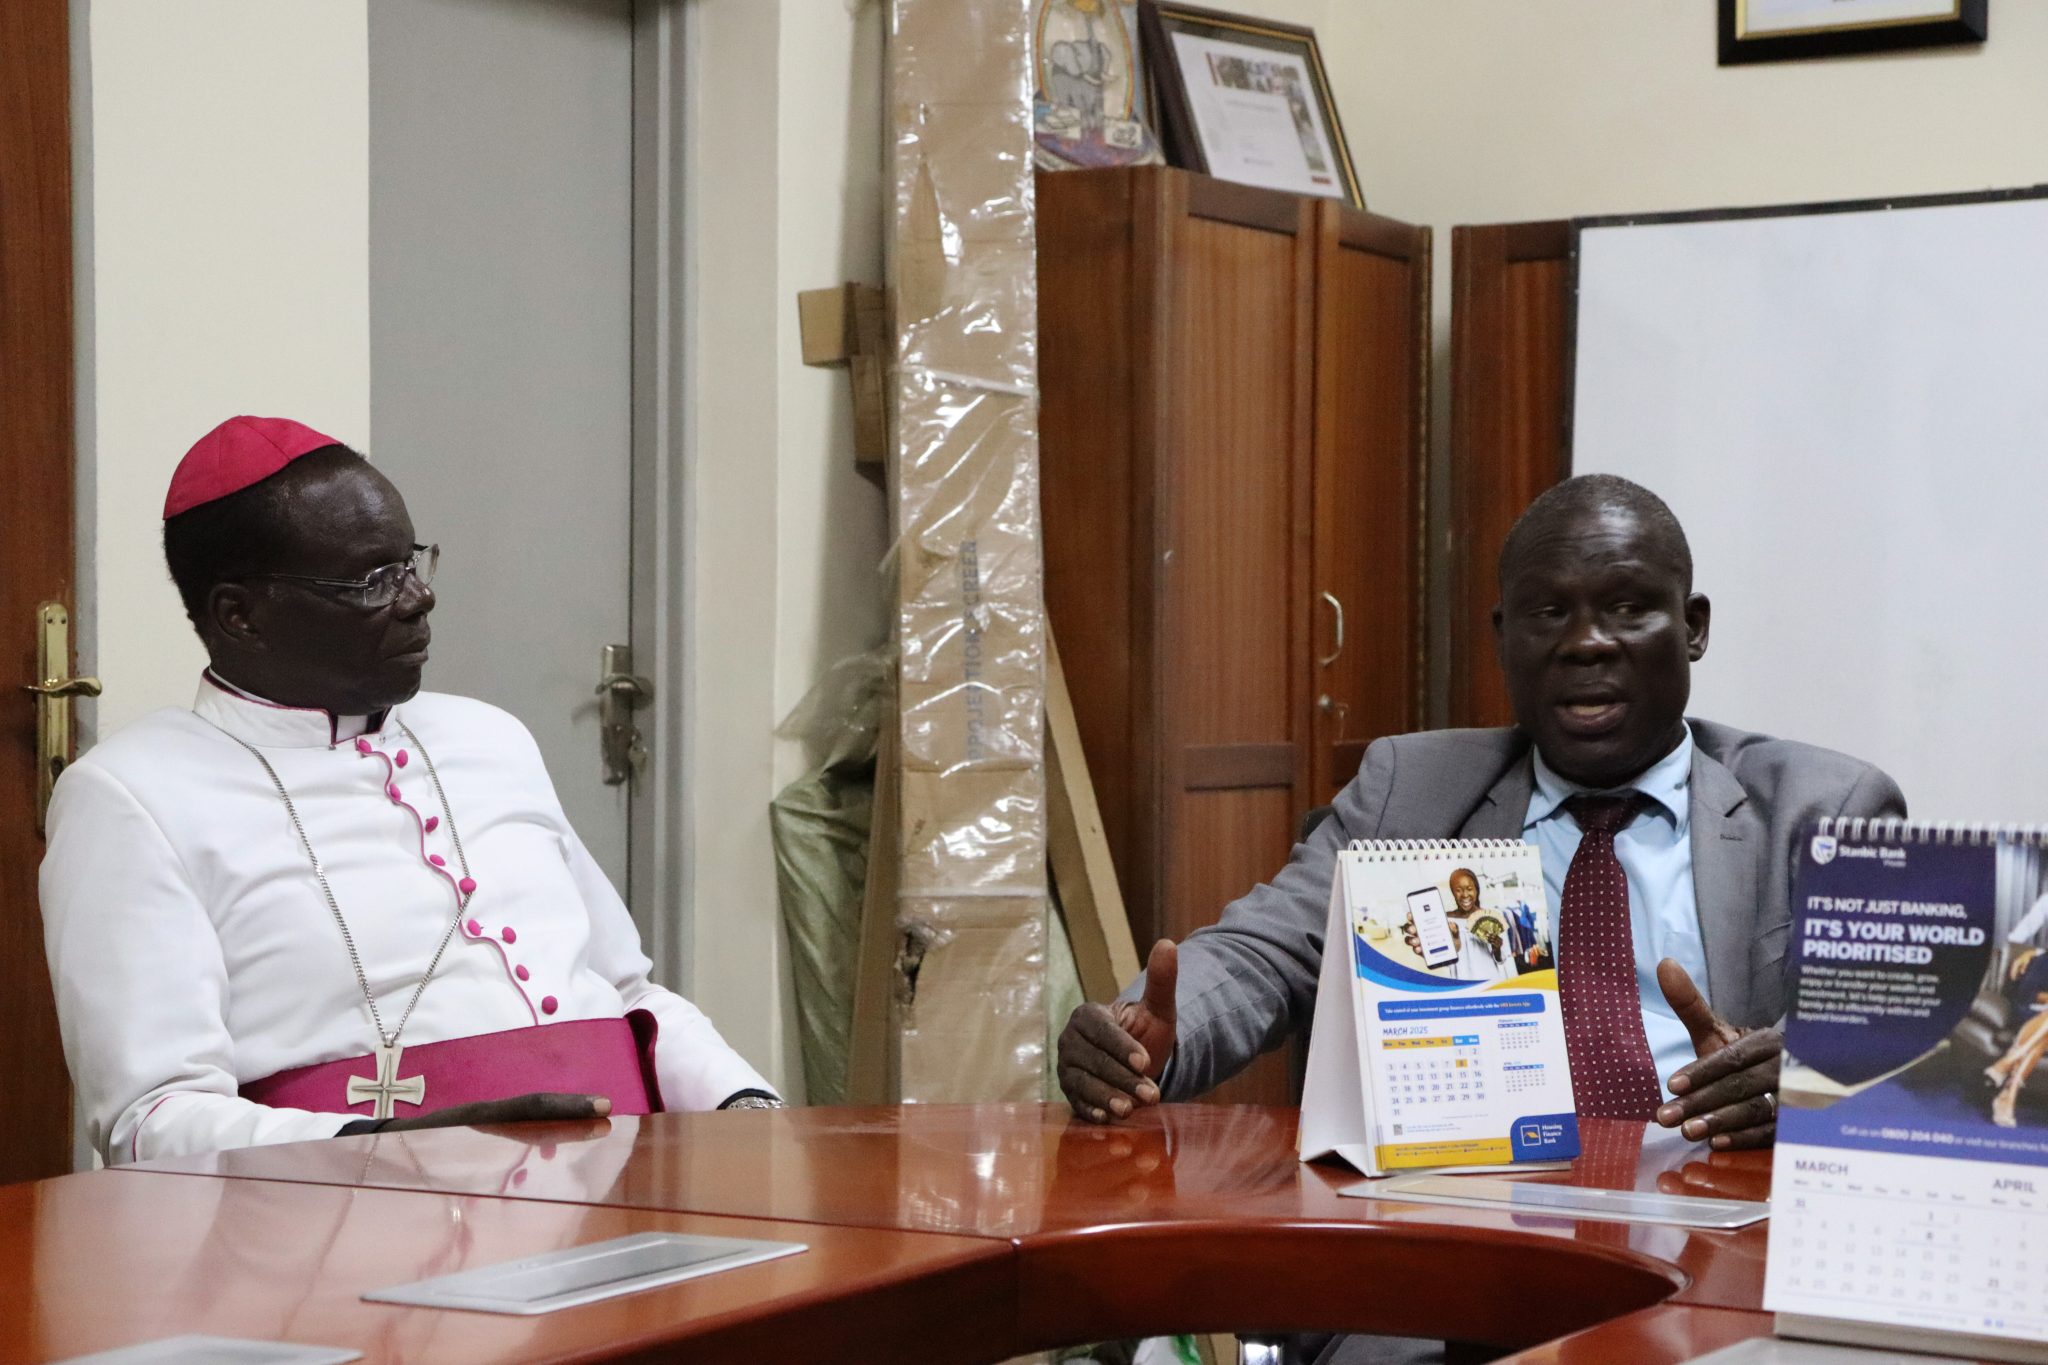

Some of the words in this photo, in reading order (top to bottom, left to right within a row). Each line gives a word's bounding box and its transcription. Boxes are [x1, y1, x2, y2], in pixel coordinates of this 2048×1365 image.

[1838, 844, 1877, 858] Stanbic
[1879, 846, 1906, 859] Bank
[1806, 896, 1833, 912] IT'S
[1834, 898, 1865, 912] NOT
[1866, 899, 1900, 915] JUST
[1900, 901, 1968, 919] BANKING,
[1804, 918, 1843, 938] IT'S
[1847, 920, 1904, 942] YOUR
[1908, 924, 1985, 946] WORLD
[1802, 939, 1933, 964] PRIORITISED
[1383, 1027, 1408, 1036] MARCH
[1410, 1026, 1428, 1034] 2025
[1881, 1127, 1909, 1140] 0800
[1795, 1160, 1848, 1176] MARCH
[1992, 1178, 2037, 1194] APRIL
